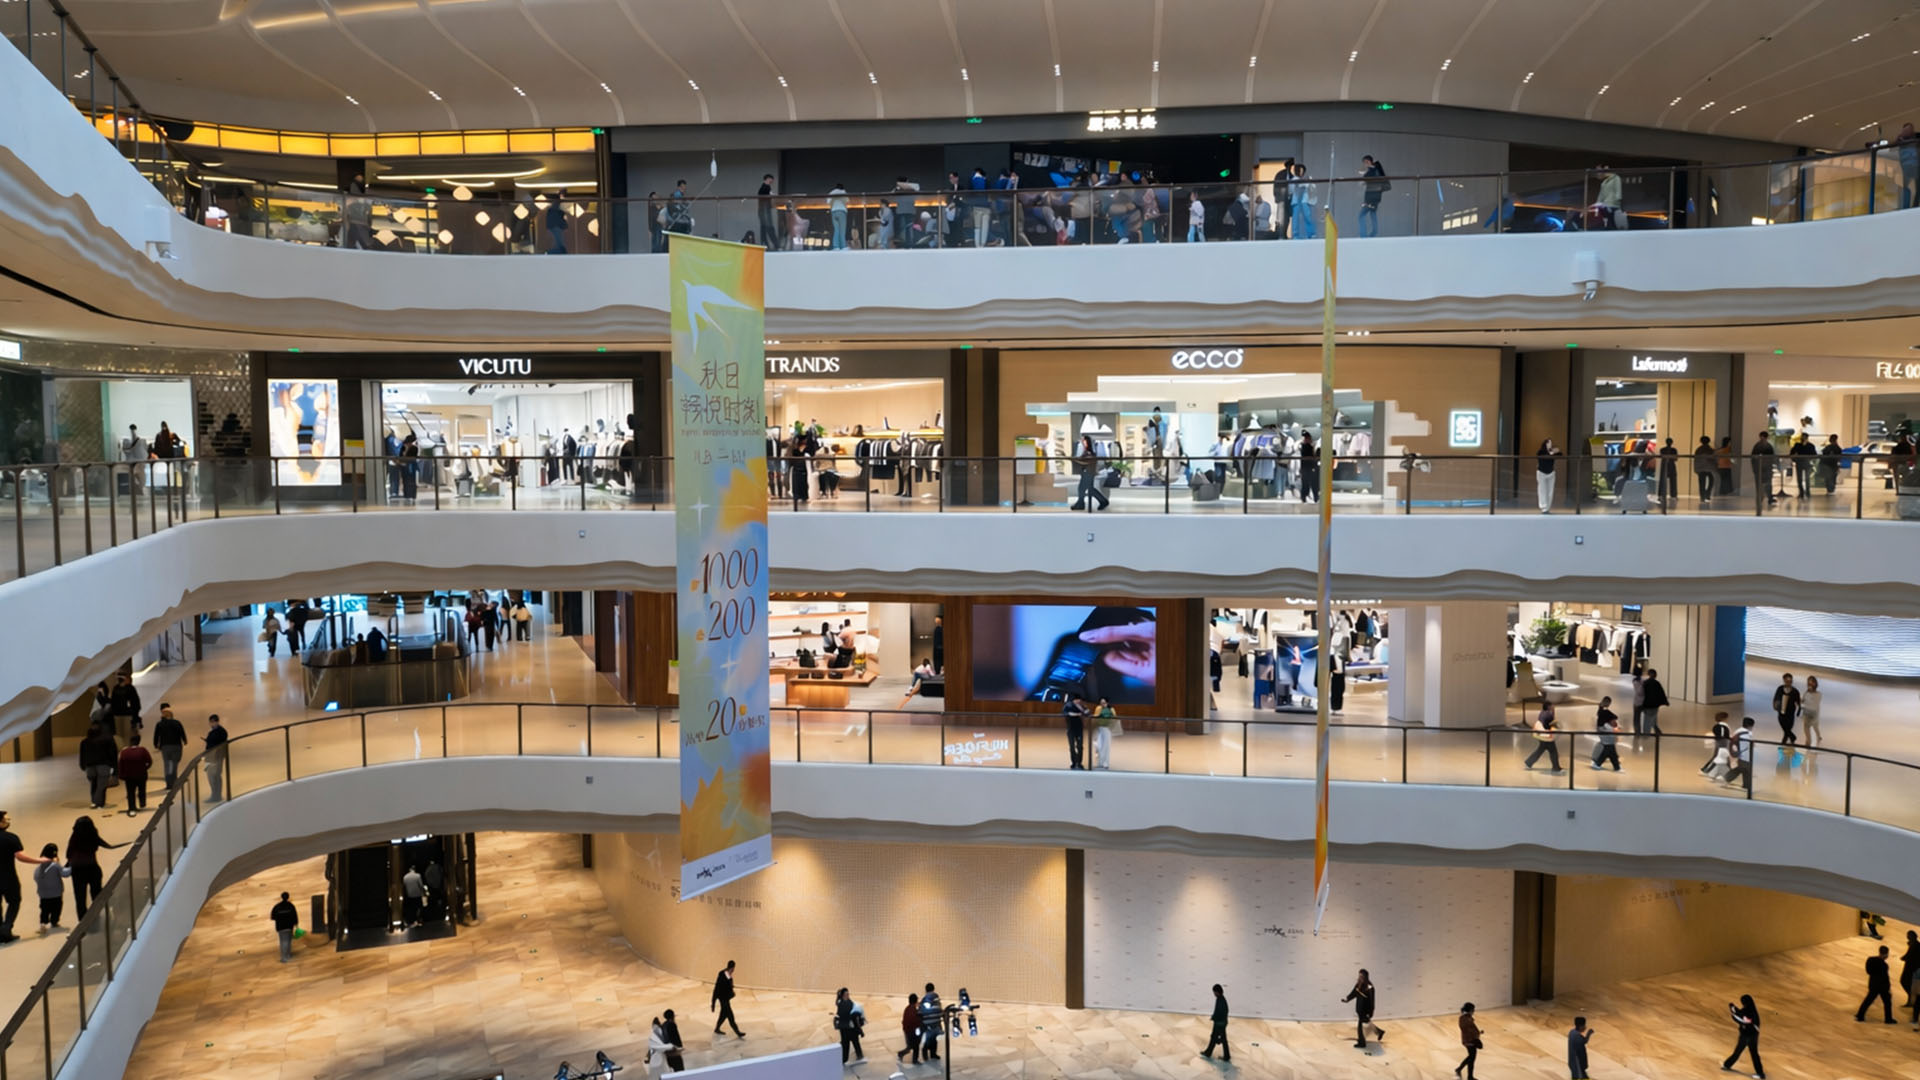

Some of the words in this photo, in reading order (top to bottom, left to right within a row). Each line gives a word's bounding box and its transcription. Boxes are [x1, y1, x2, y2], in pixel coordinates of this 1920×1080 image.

[459, 358, 532, 375] VICUTU
[766, 356, 840, 373] TRANDS
[1171, 348, 1244, 370] ecco
[699, 360, 739, 389] 秋日
[701, 547, 759, 594] 1000
[708, 596, 755, 641] 200
[706, 696, 736, 741] 20
